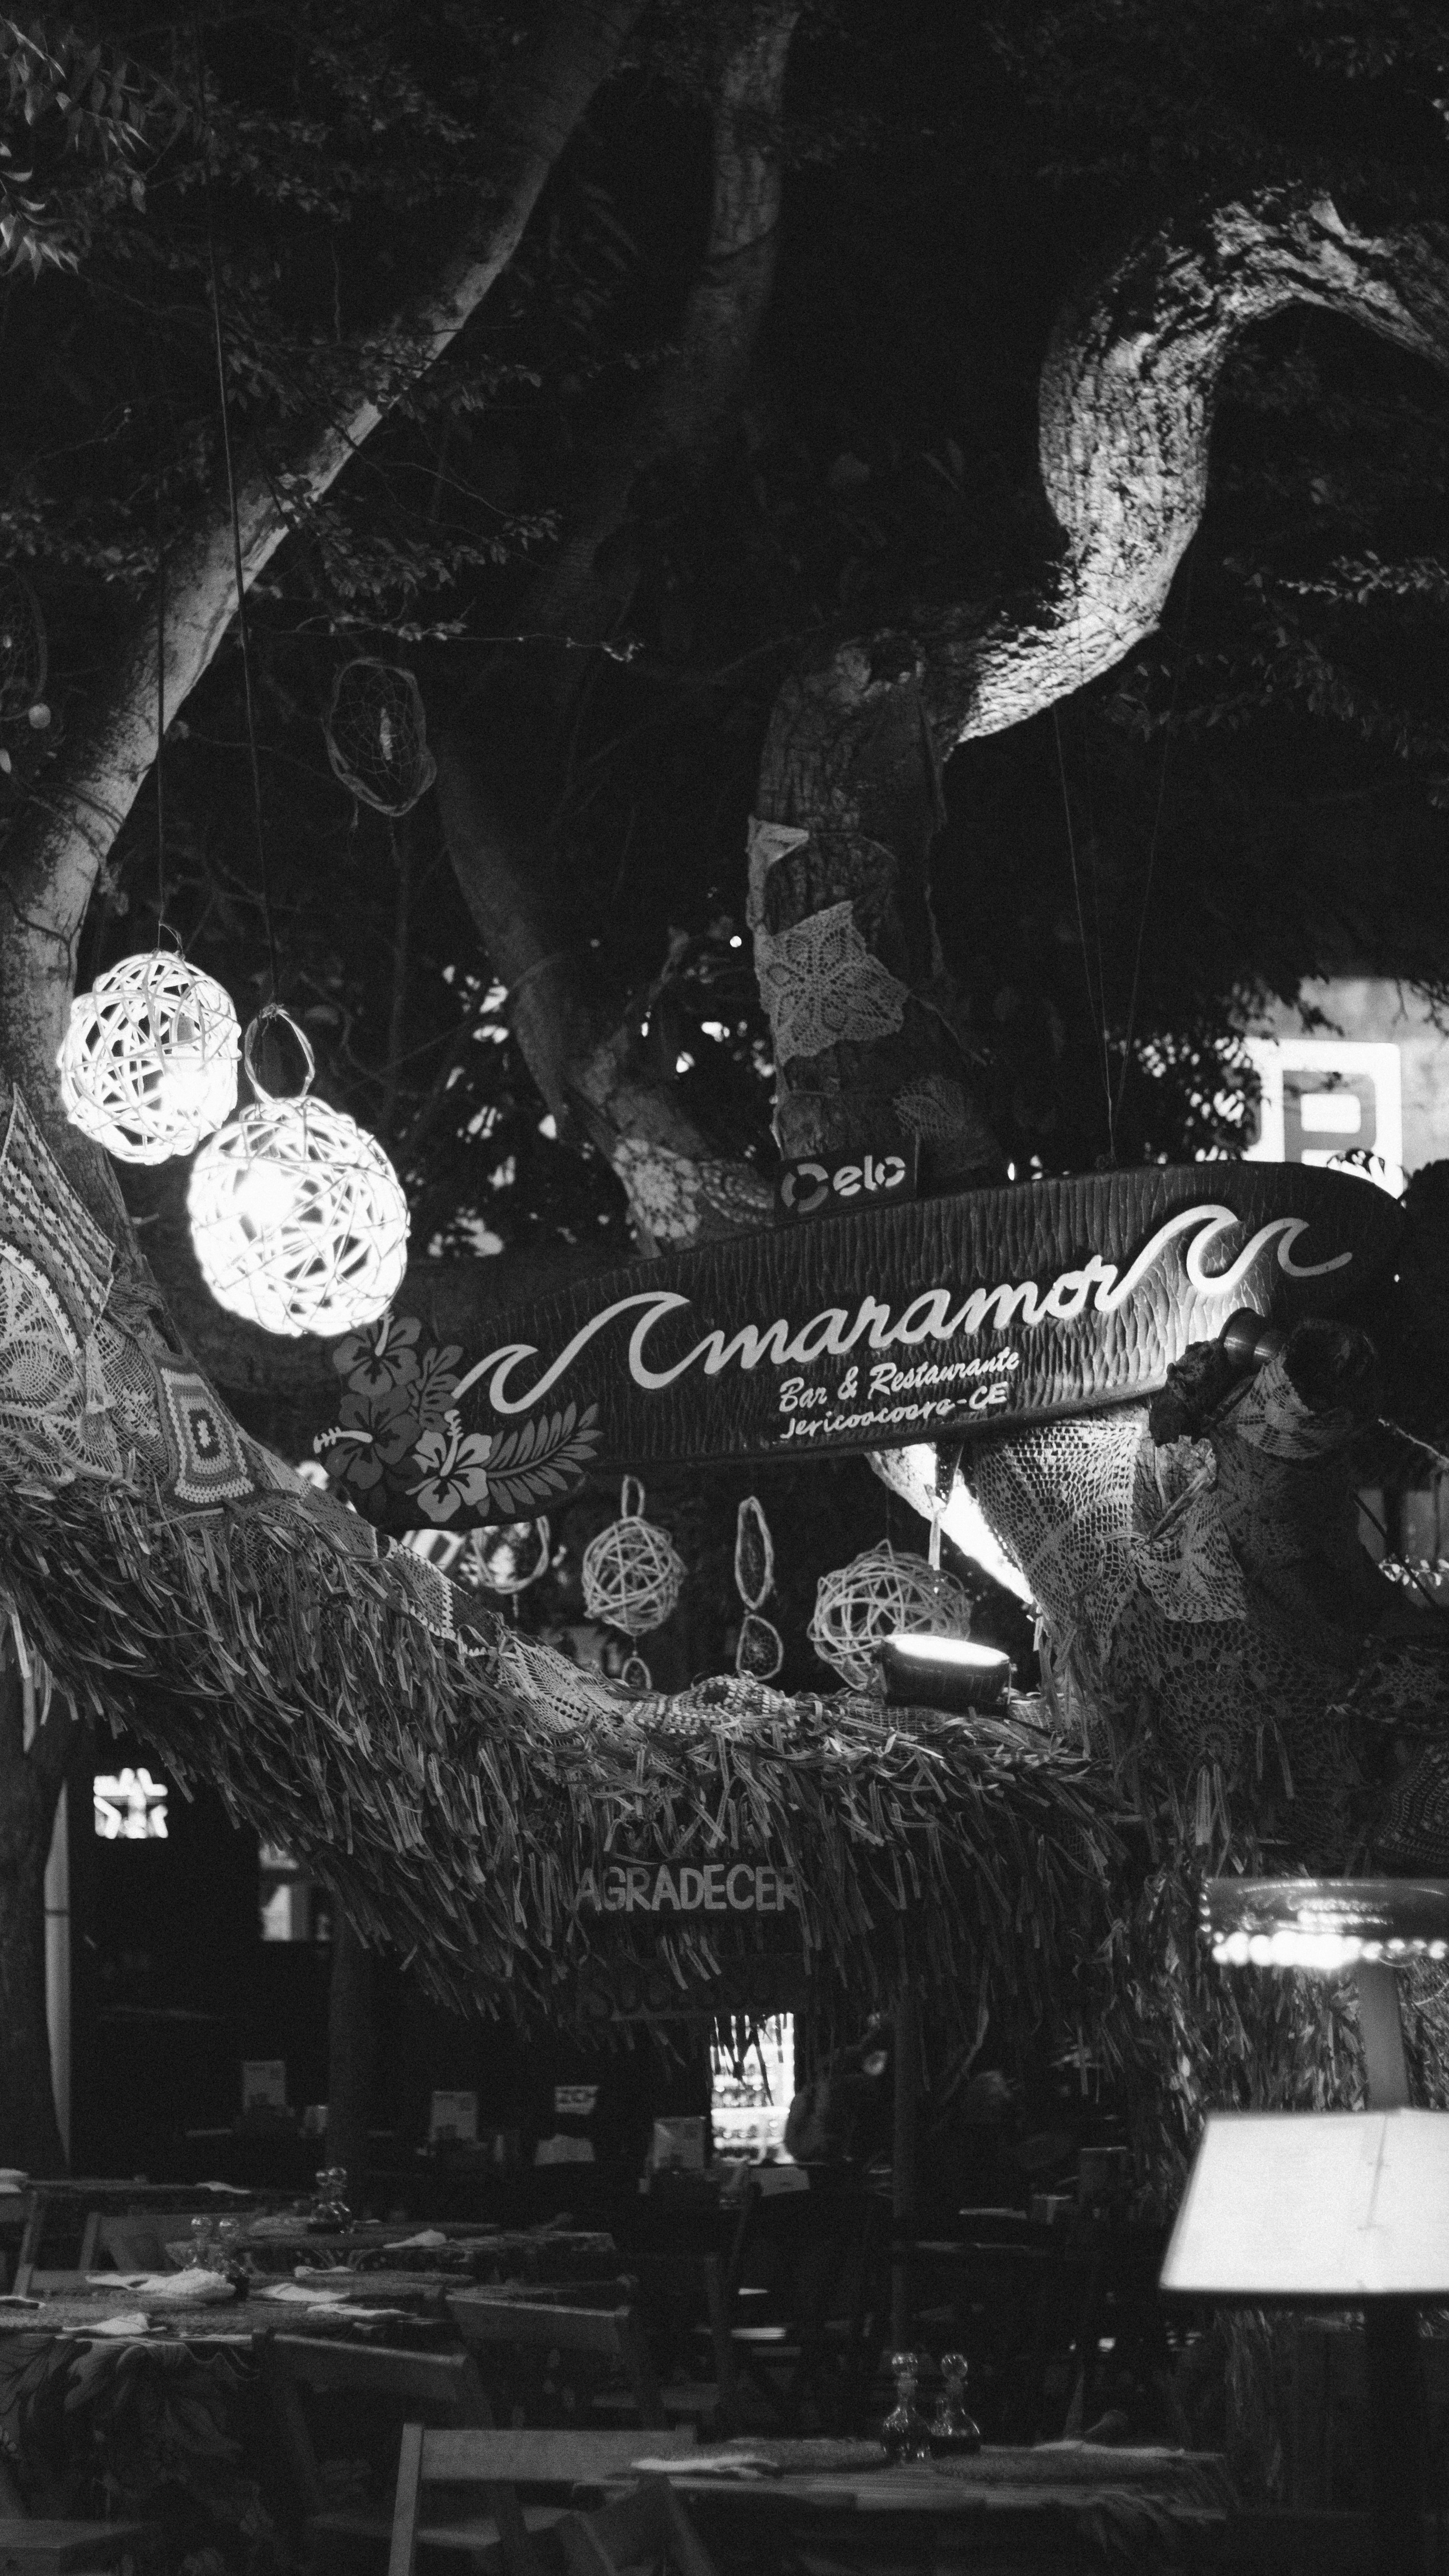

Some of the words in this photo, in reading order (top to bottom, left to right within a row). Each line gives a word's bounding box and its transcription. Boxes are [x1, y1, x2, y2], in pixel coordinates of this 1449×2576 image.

[779, 1377, 828, 1413] Bar
[837, 1366, 859, 1400] &
[867, 1346, 1020, 1400] Restaurante
[573, 1864, 801, 1911] AGRADECER
